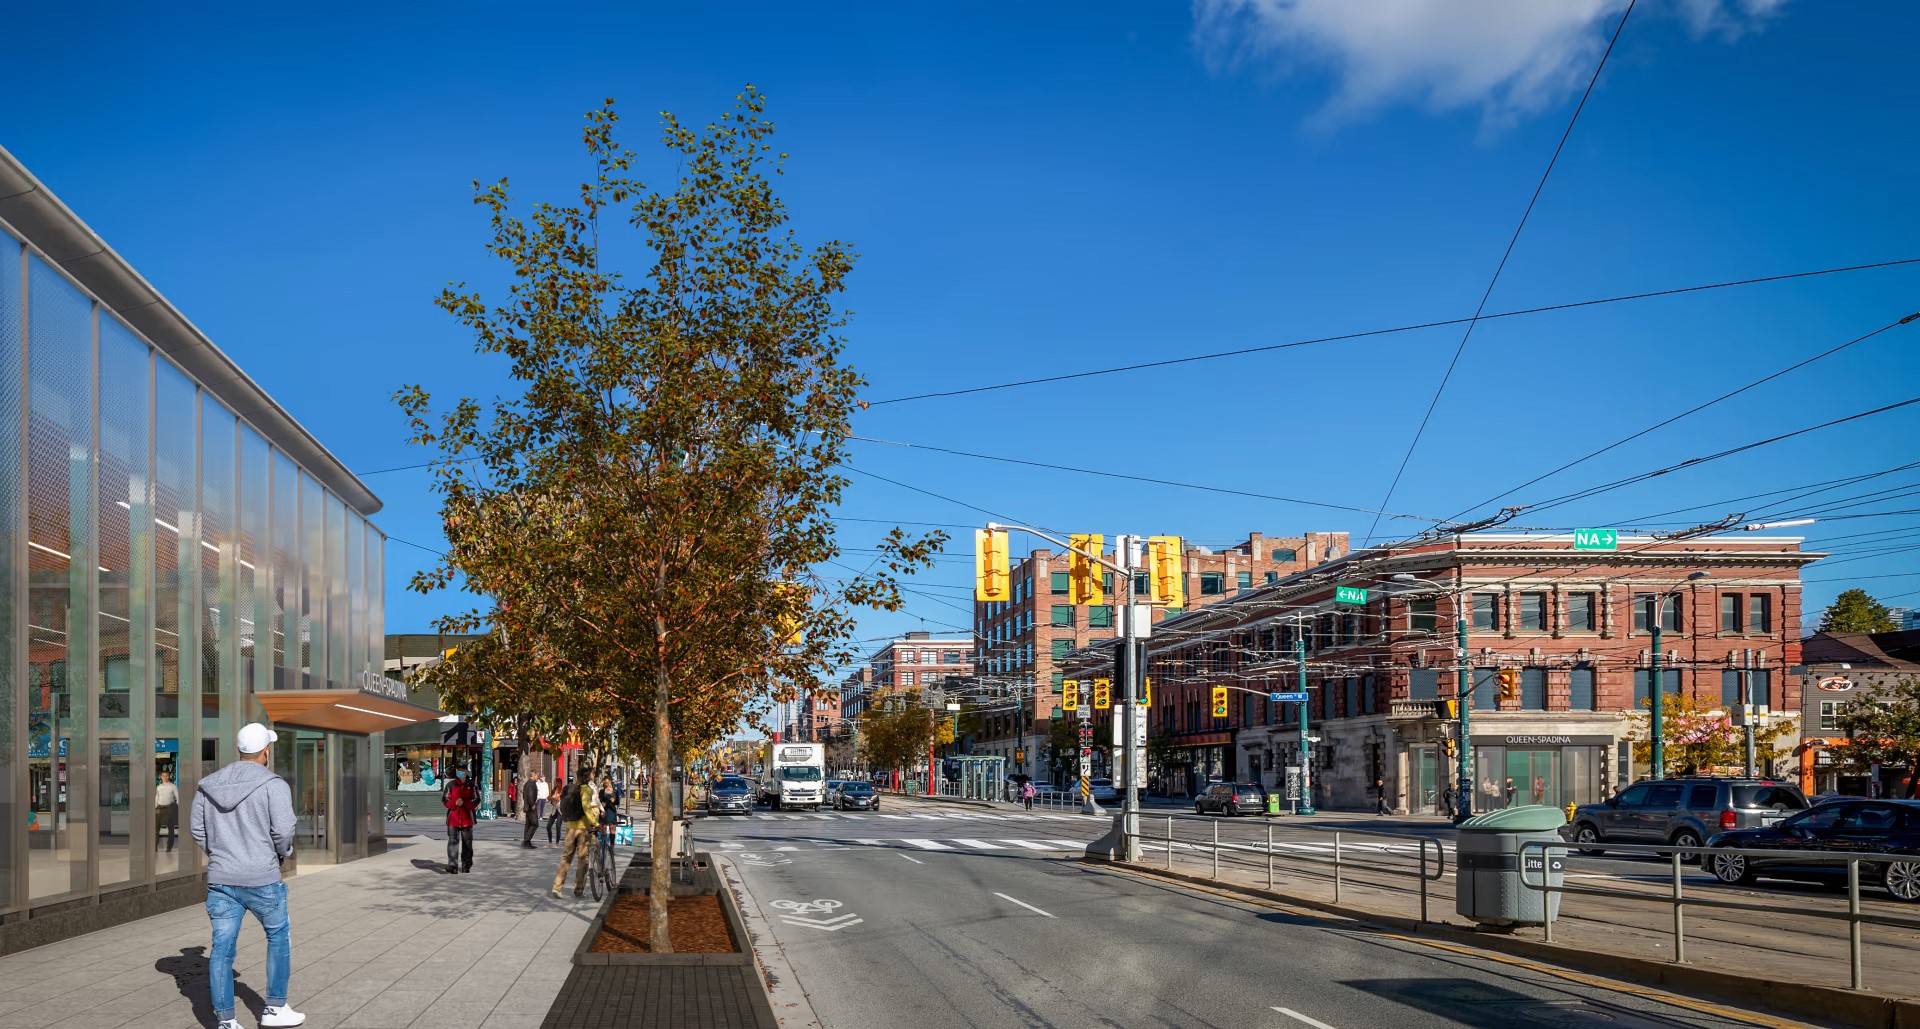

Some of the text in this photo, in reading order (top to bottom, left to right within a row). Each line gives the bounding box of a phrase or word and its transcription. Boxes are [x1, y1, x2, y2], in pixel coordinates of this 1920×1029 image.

[1577, 533, 1600, 545] NA
[1347, 590, 1364, 601] NA
[363, 670, 408, 701] QUEEN-SPADINA
[1506, 735, 1571, 744] QUEEN-SPADINA
[1525, 859, 1543, 868] itte
